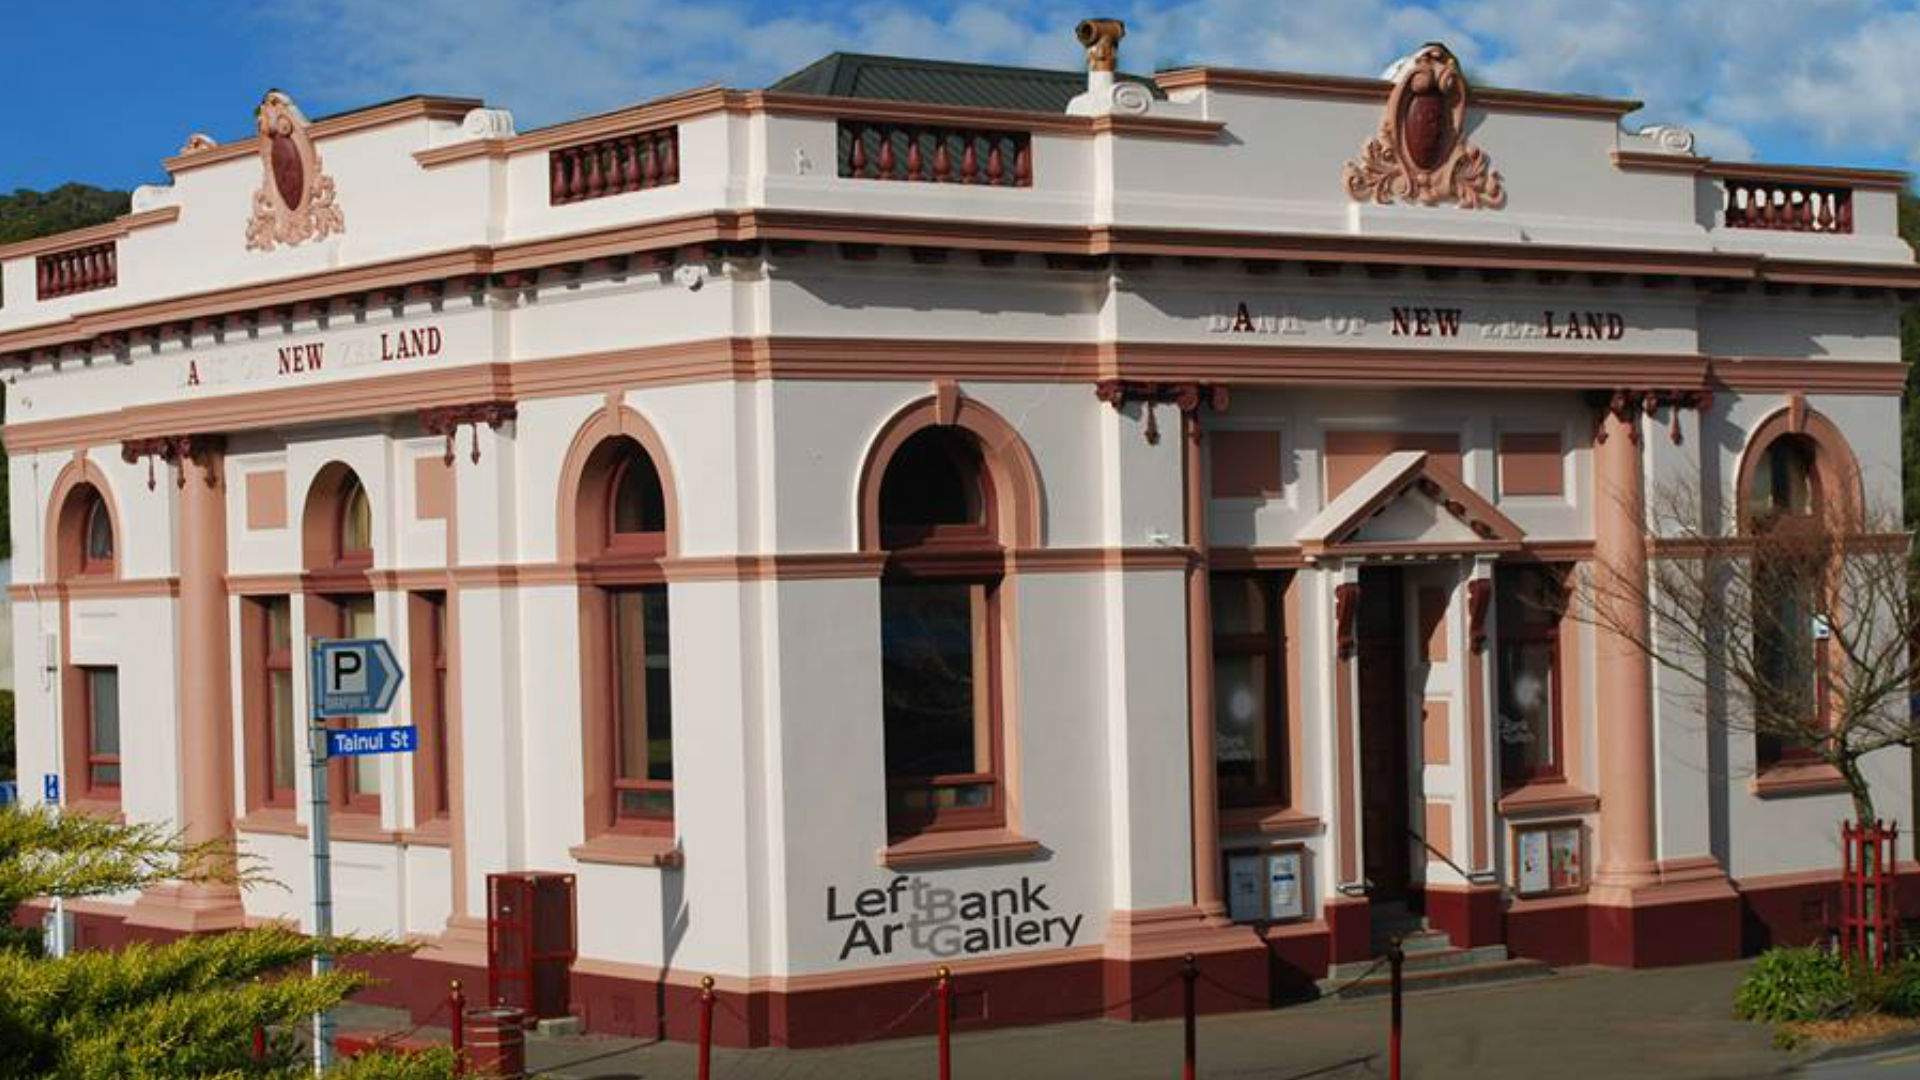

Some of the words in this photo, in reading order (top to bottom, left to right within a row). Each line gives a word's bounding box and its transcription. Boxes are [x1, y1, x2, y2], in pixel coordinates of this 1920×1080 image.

[1391, 306, 1462, 337] NEW
[278, 342, 324, 375] NEW
[334, 650, 362, 690] P
[335, 731, 384, 752] Tainui
[390, 729, 410, 749] St
